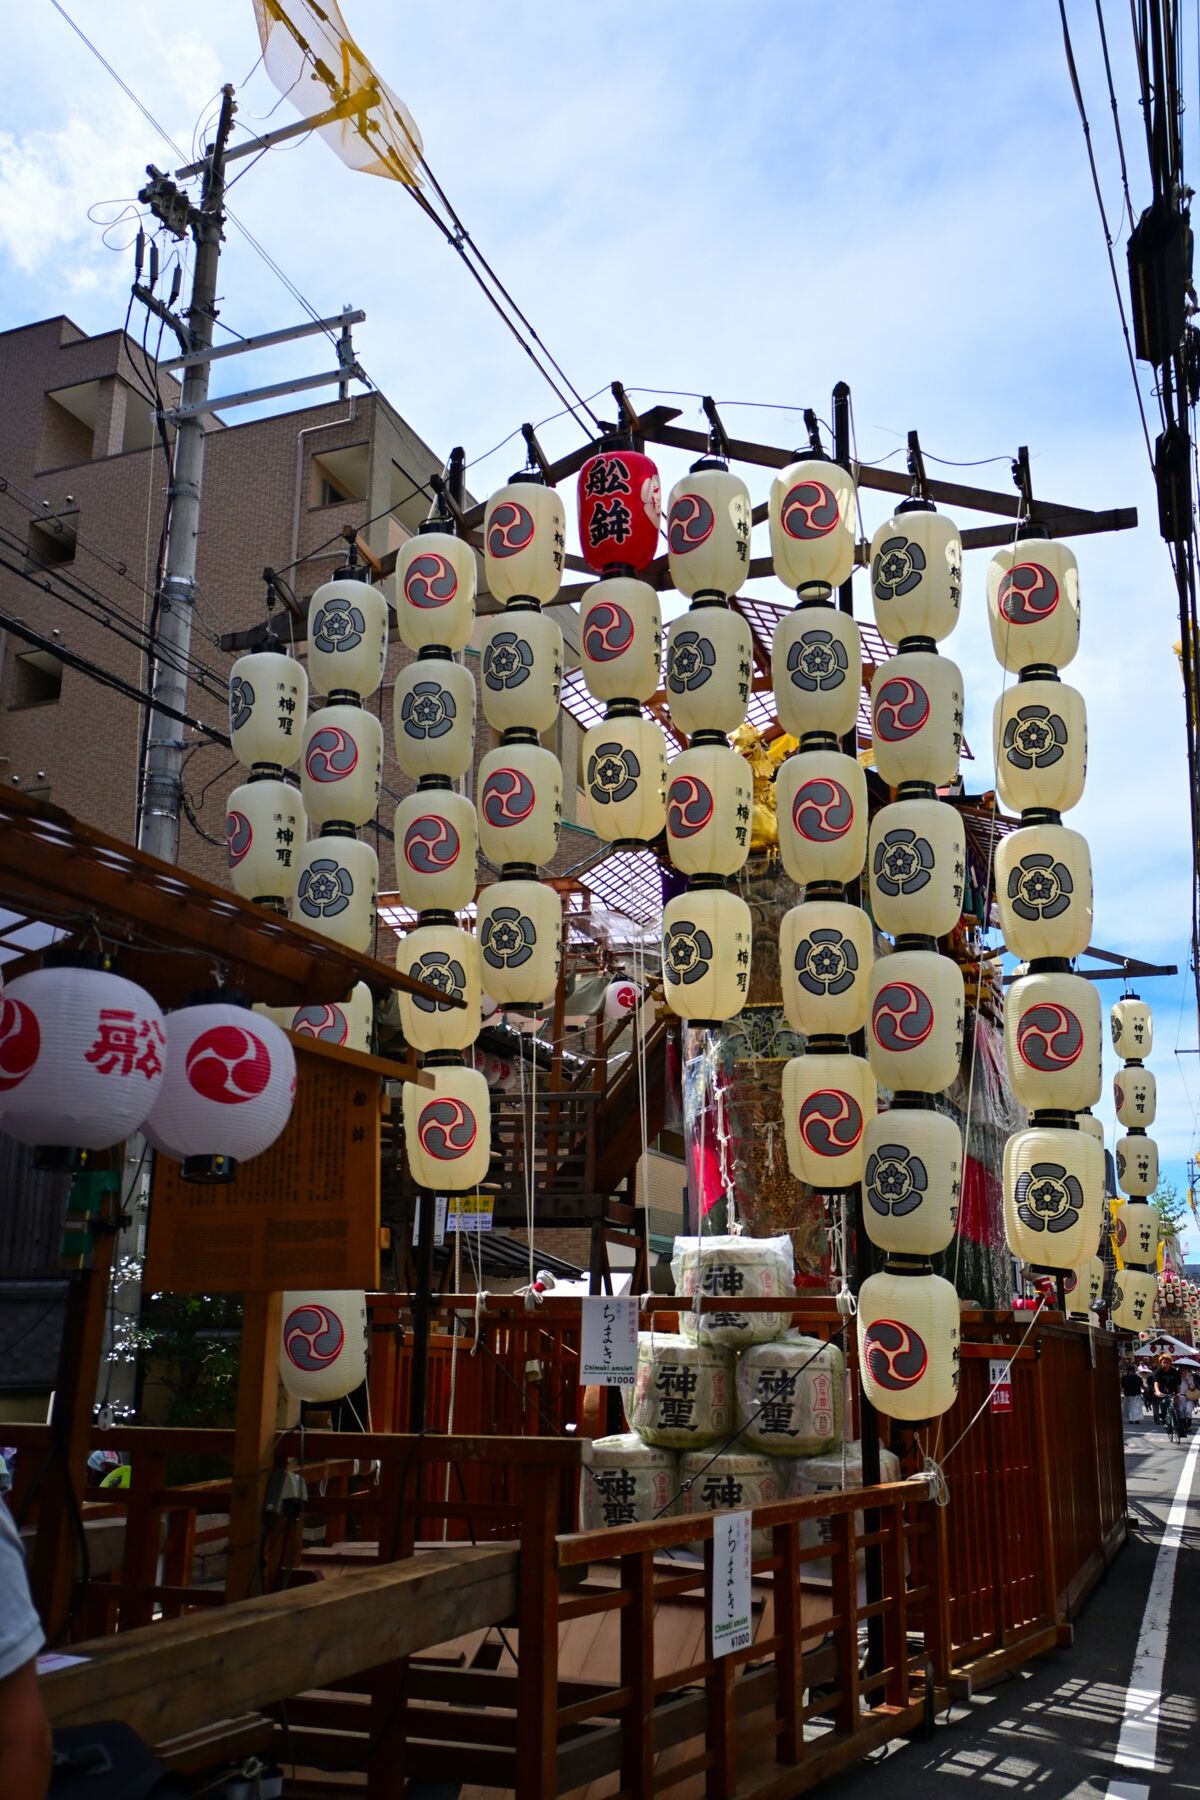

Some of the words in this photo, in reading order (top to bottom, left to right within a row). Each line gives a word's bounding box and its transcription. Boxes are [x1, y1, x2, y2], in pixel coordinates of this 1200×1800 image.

[736, 518, 749, 562] 神聖
[738, 659, 750, 703] 神聖
[277, 696, 296, 736] 神聖
[736, 802, 750, 847] 神聖
[275, 827, 295, 868] 神聖
[736, 949, 749, 993] 神聖
[1134, 1024, 1144, 1044] 神聖
[1136, 1093, 1146, 1113] 神聖
[603, 1304, 616, 1364] ちまき
[606, 1376, 635, 1384] ¥1000
[656, 1365, 698, 1431] 神聖
[756, 1369, 799, 1437] 神聖
[727, 1524, 736, 1618] ちまき
[731, 1632, 750, 1648] ¥1000
